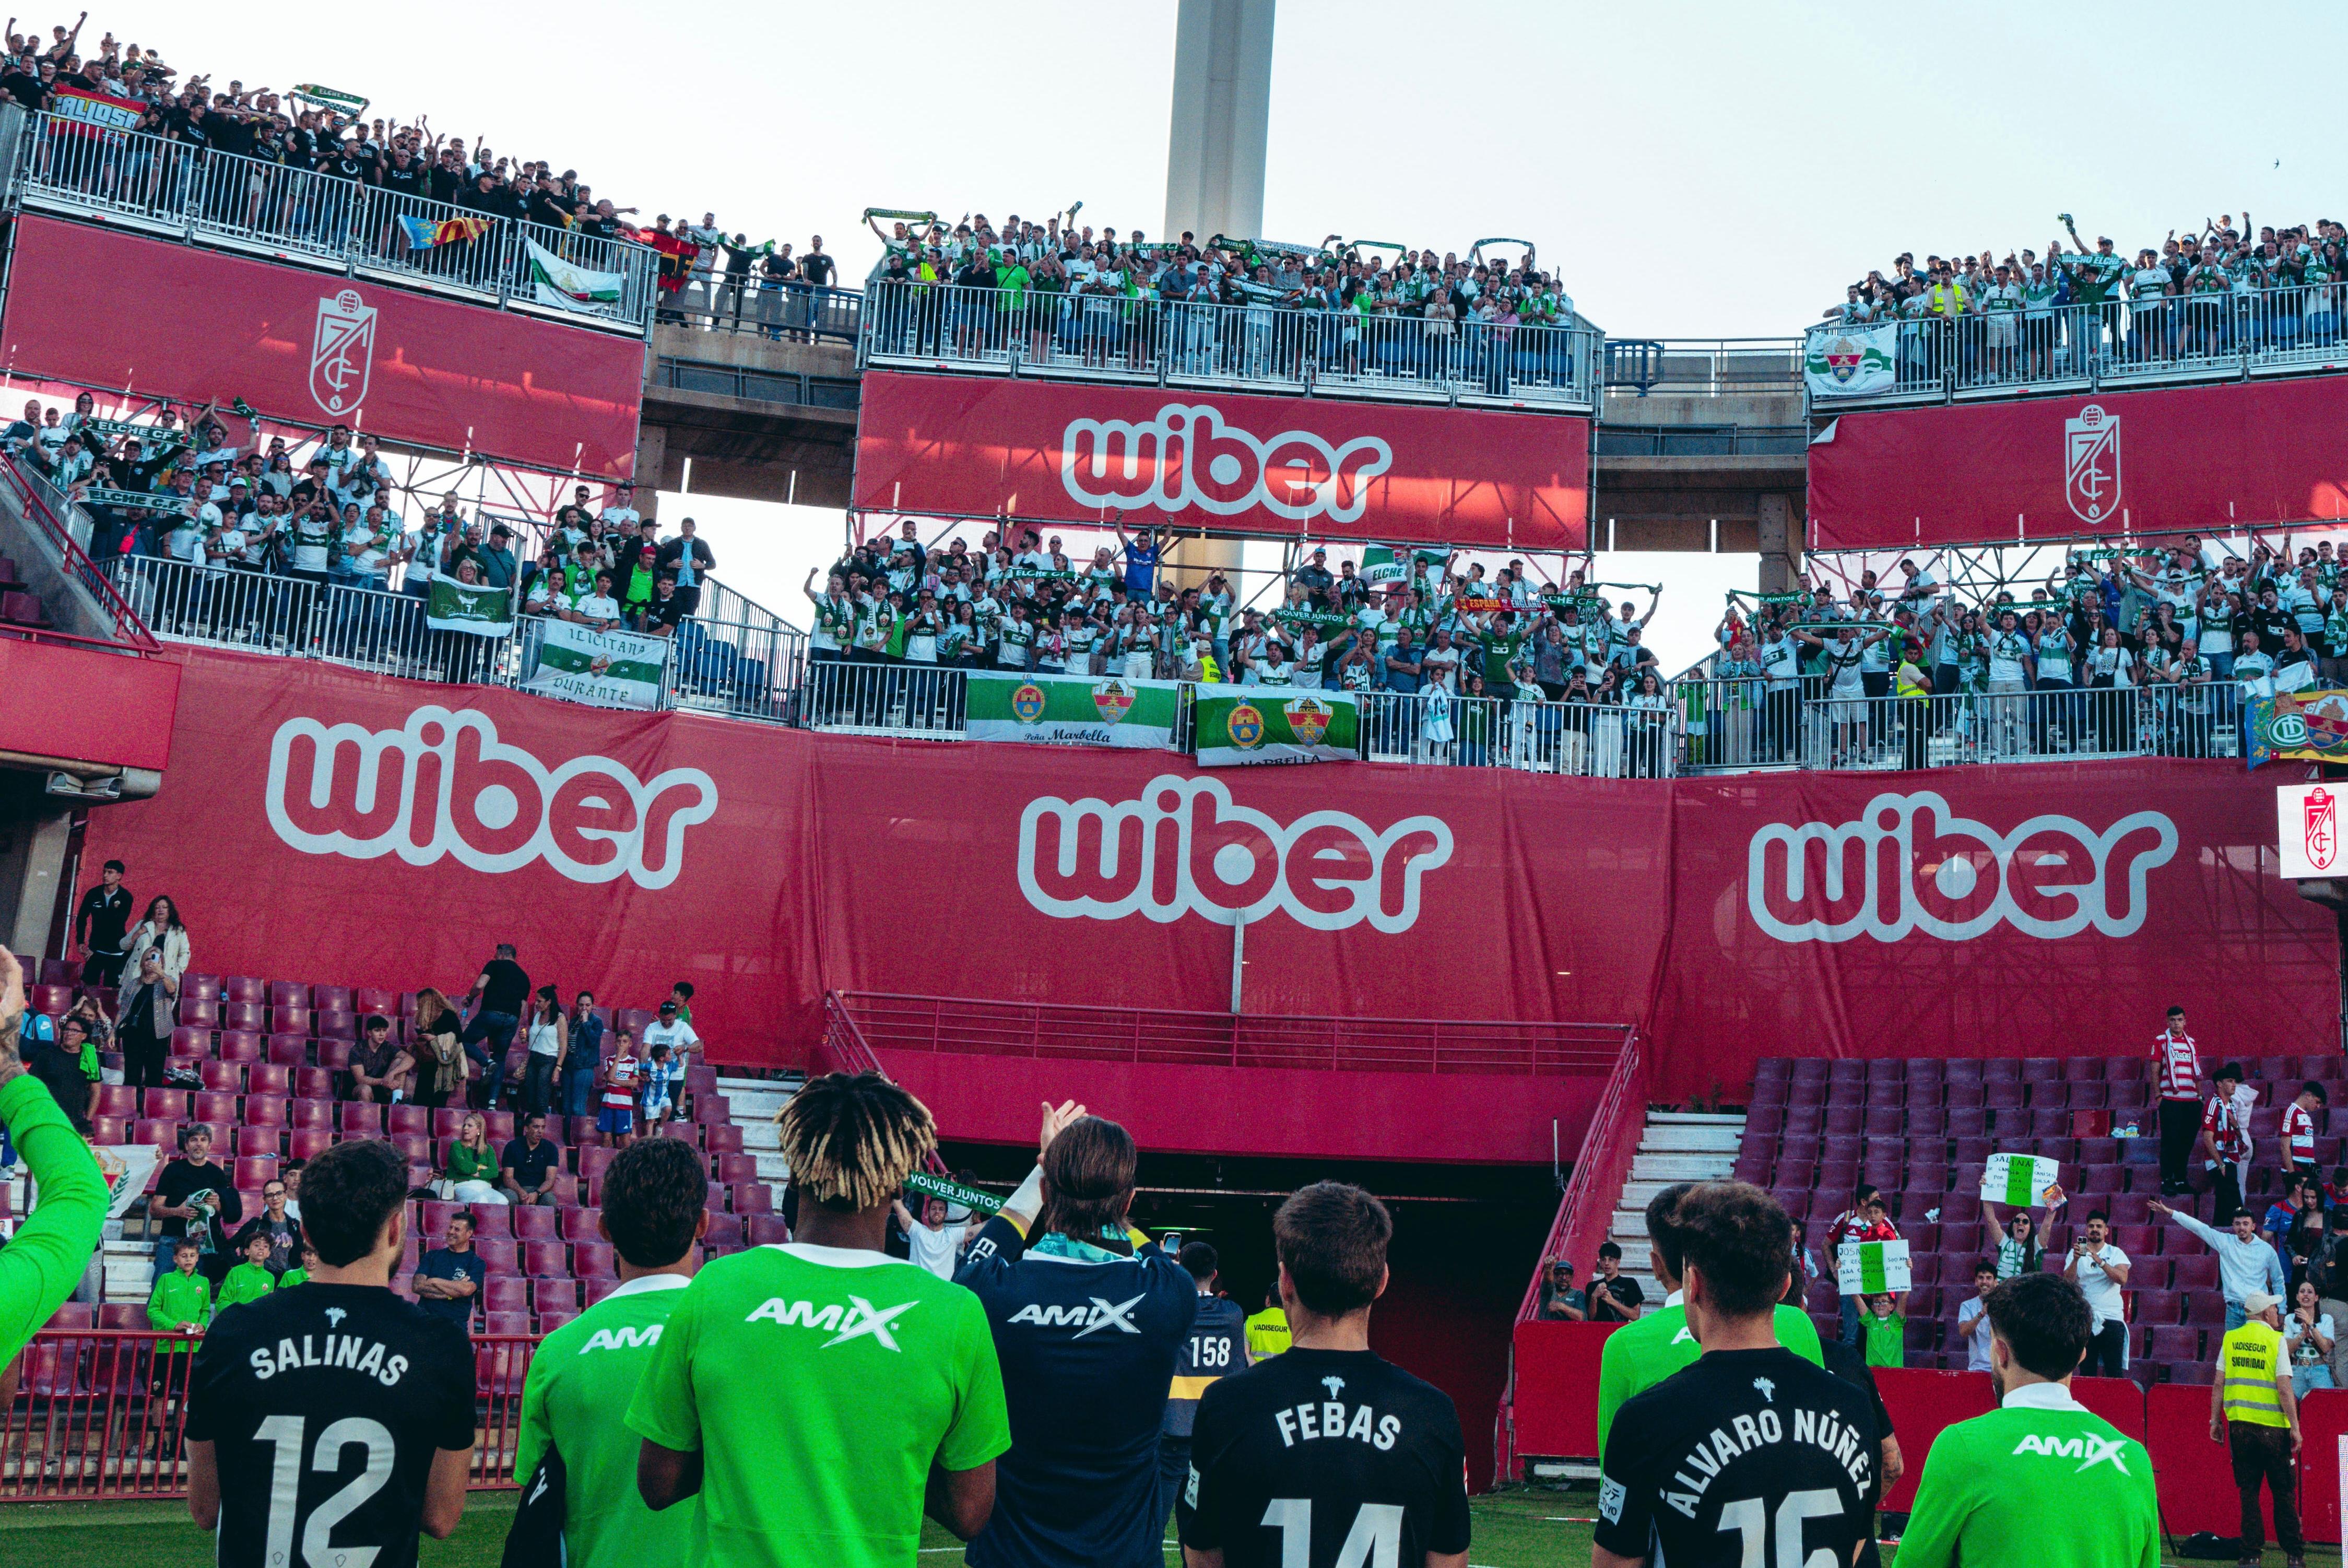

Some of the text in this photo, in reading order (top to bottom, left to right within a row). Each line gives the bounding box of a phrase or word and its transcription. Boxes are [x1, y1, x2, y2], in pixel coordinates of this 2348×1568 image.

[320, 88, 341, 98] ELCHE
[2093, 256, 2120, 265] ELCHE
[99, 421, 173, 439] ELCHE CF
[1061, 403, 1392, 523] wiber
[90, 490, 182, 510] ELCHE C.F.
[1373, 568, 1403, 581] ELCHE
[466, 605, 472, 613] 7
[1511, 599, 1542, 608] ENGLAND
[1542, 594, 1574, 604] LCHE
[1277, 609, 1309, 620] VOLVER
[1311, 612, 1343, 622] JUNTOS
[553, 678, 630, 702] DURANTE
[1048, 728, 1111, 743] Marbella
[266, 706, 717, 890] wiber
[1016, 775, 1454, 933] wiber
[1748, 790, 2180, 941] wiber
[911, 1174, 1000, 1210] VOLVER JUNTOS
[1254, 1324, 1288, 1333] VADISEGUR
[1190, 1337, 1231, 1367] 158
[2232, 1342, 2267, 1353] VADISEGUR
[251, 1334, 409, 1387] SALINAS
[1276, 1402, 1401, 1451] FEBAS
[1660, 1408, 1872, 1519] ÁLVARO NÚÑEZ
[253, 1415, 396, 1568] 12
